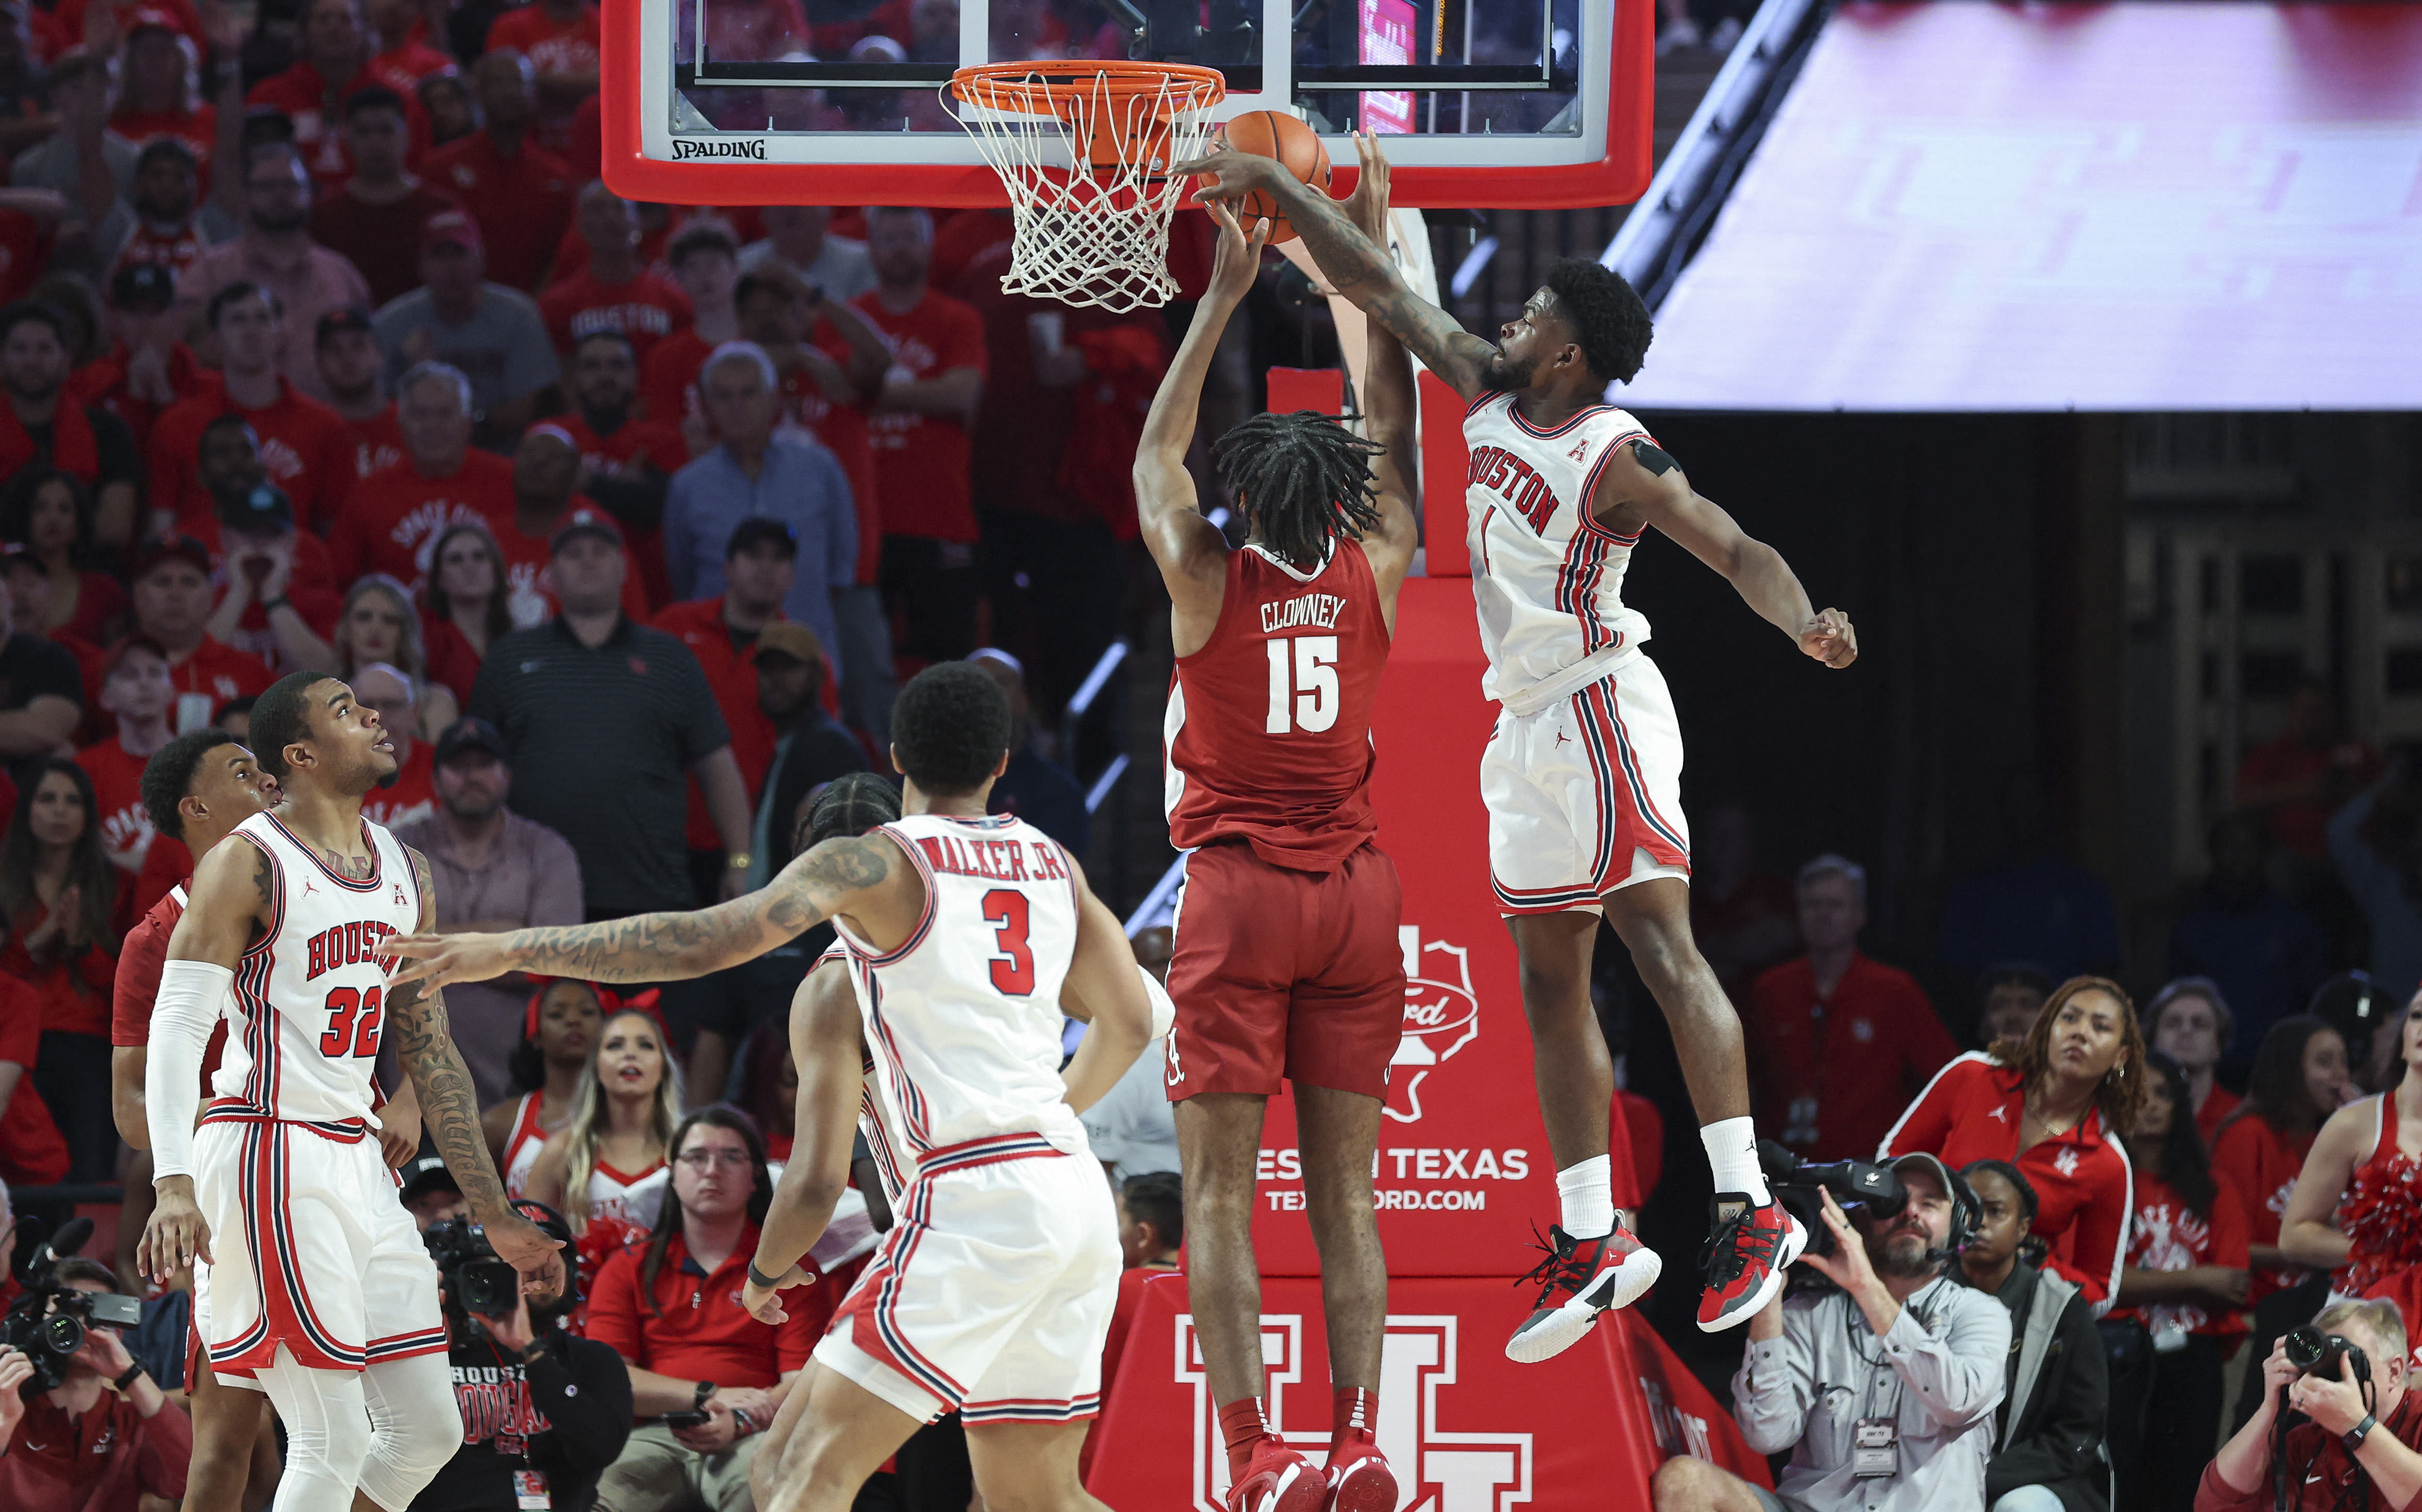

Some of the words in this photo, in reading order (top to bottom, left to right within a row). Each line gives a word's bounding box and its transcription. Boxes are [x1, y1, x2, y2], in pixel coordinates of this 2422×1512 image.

[672, 140, 764, 160] SPALDING
[1467, 445, 1559, 538] OUSTON
[1261, 593, 1346, 633] CLOWNEY
[1266, 635, 1339, 734] 15
[916, 836, 1029, 881] WALKER
[1031, 842, 1065, 880] JR
[981, 889, 1035, 996] 3
[319, 985, 381, 1058] 32
[1256, 1149, 1303, 1180] ES
[1387, 1148, 1529, 1180] TEXAS
[1265, 1190, 1485, 1211] TEORD.COM
[453, 1380, 553, 1445] OUGA
